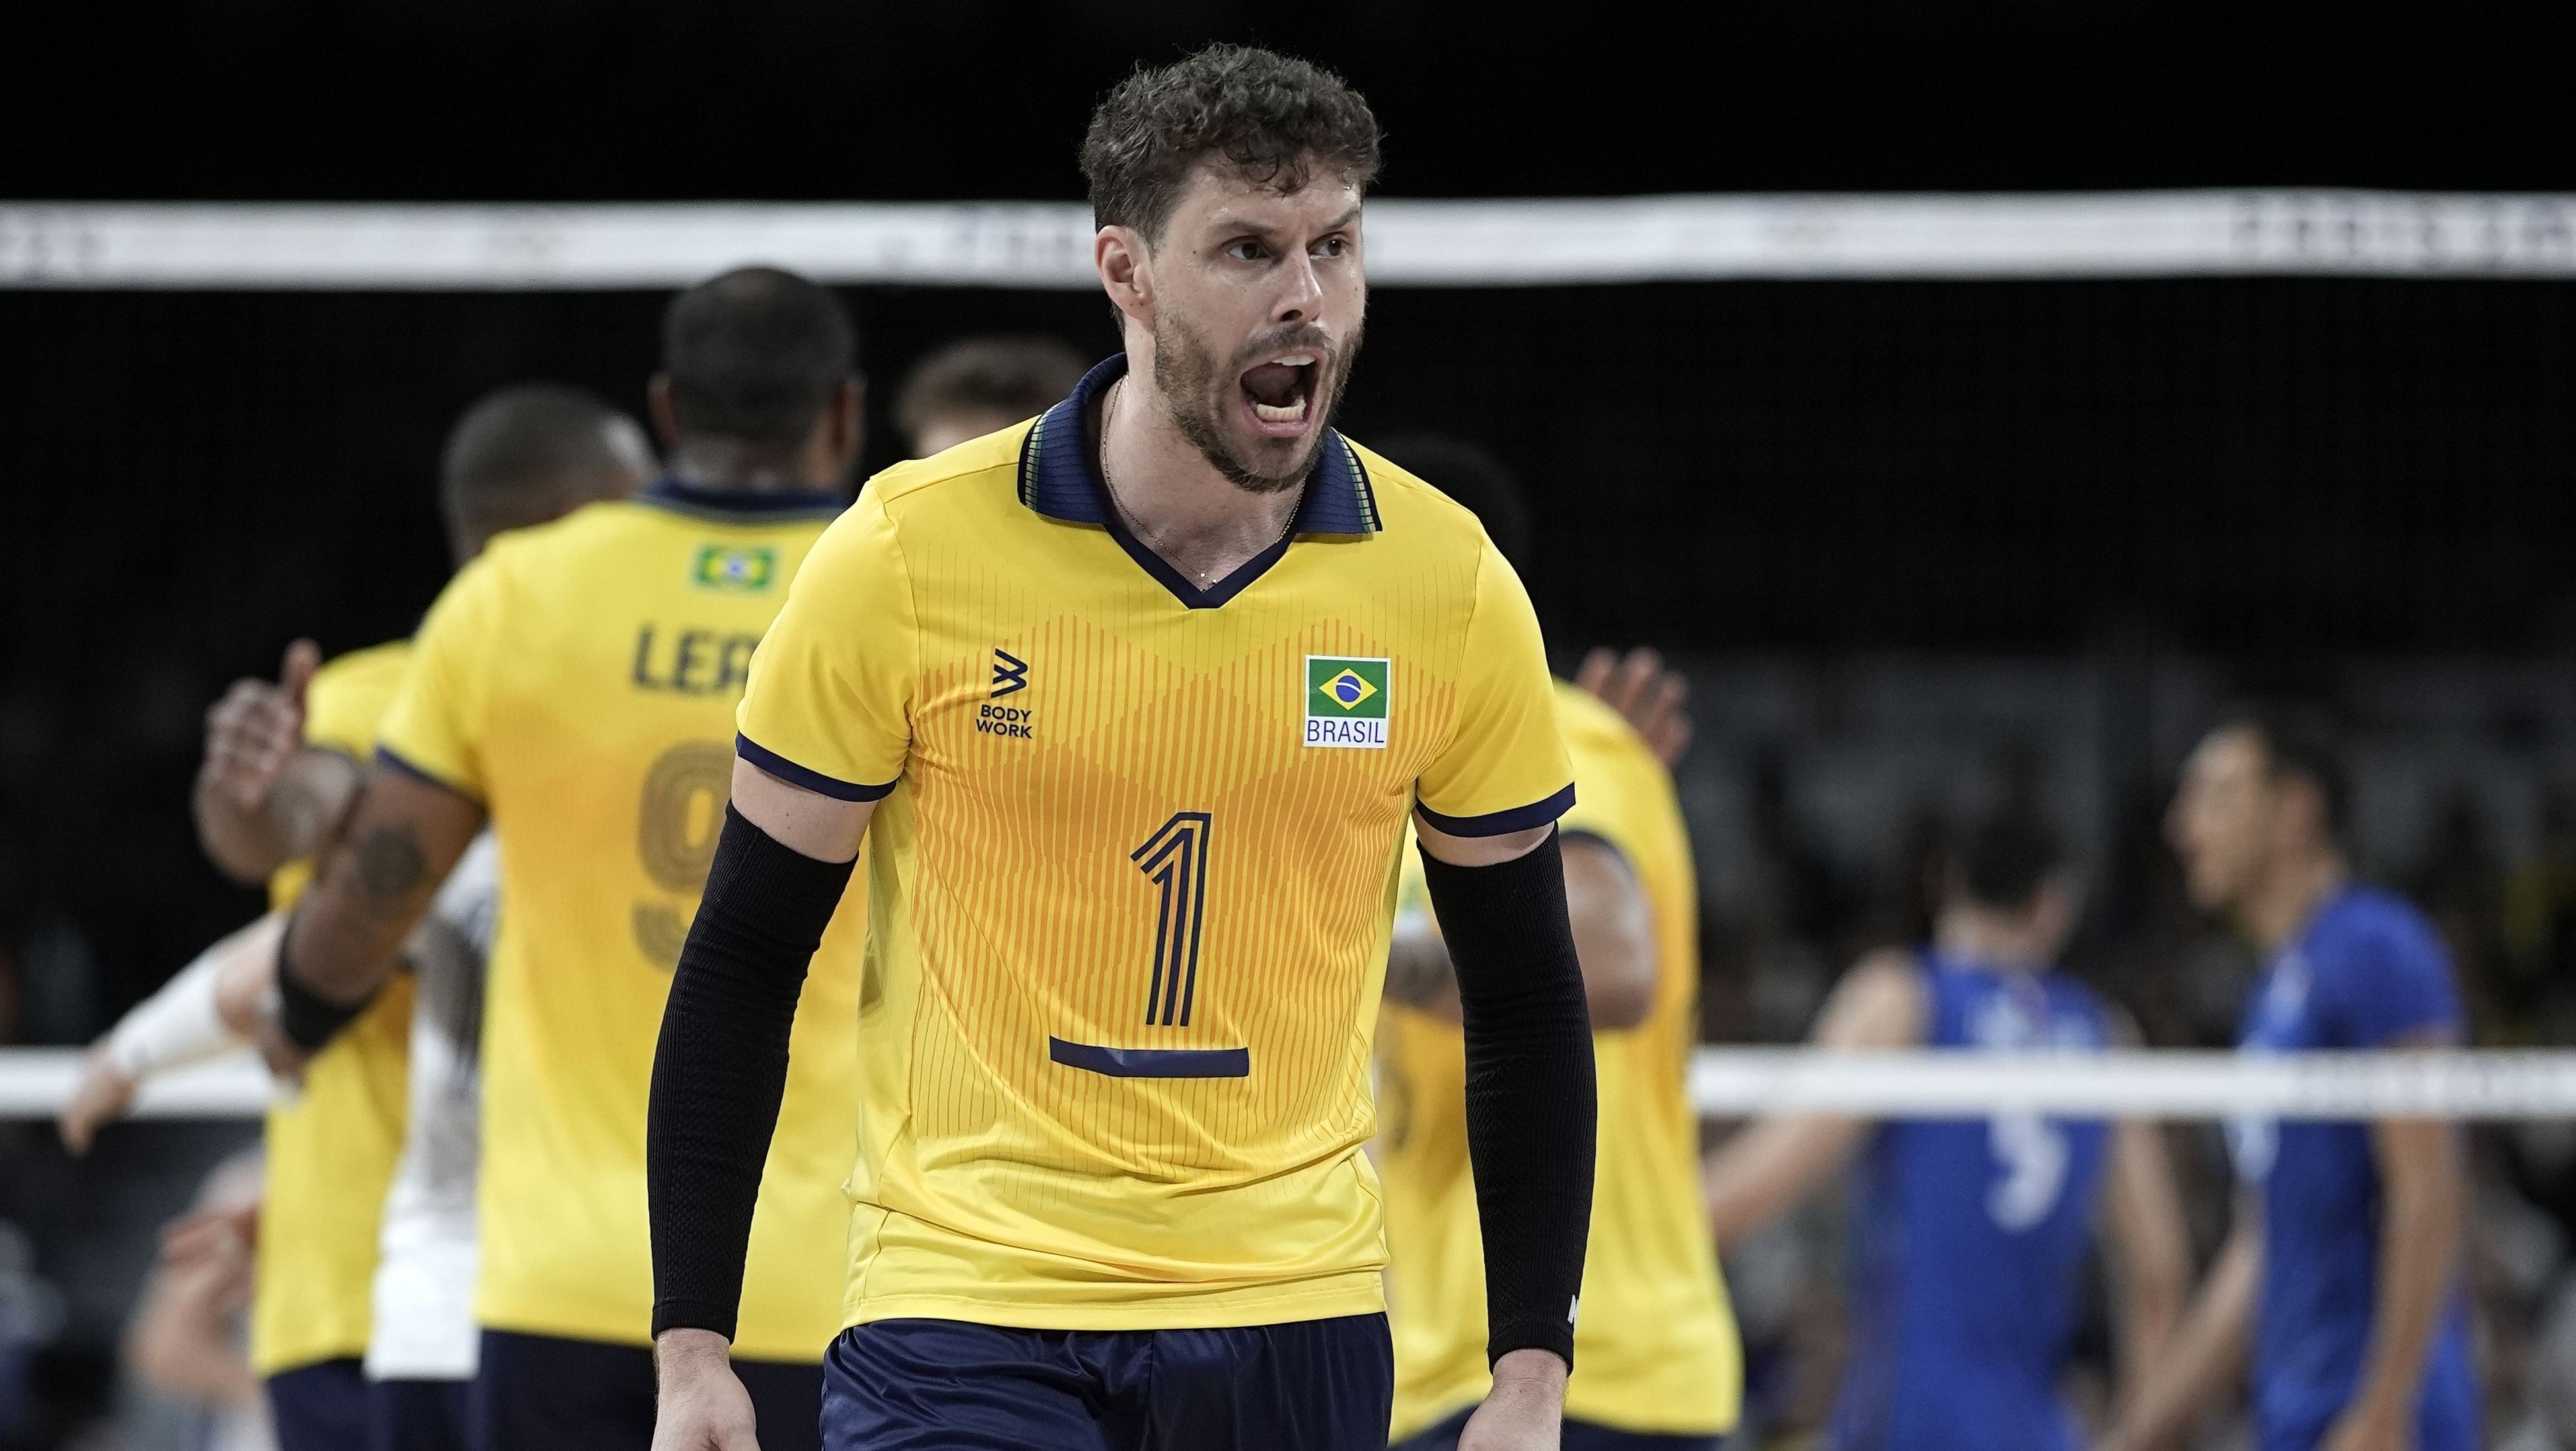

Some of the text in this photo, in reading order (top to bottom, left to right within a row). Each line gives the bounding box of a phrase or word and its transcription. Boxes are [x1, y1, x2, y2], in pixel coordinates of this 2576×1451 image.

[633, 623, 761, 699] LEA
[980, 704, 1032, 723] BODY
[976, 719, 1032, 738] WORK
[1307, 720, 1384, 743] BRASIL
[1130, 812, 1211, 1027] 1
